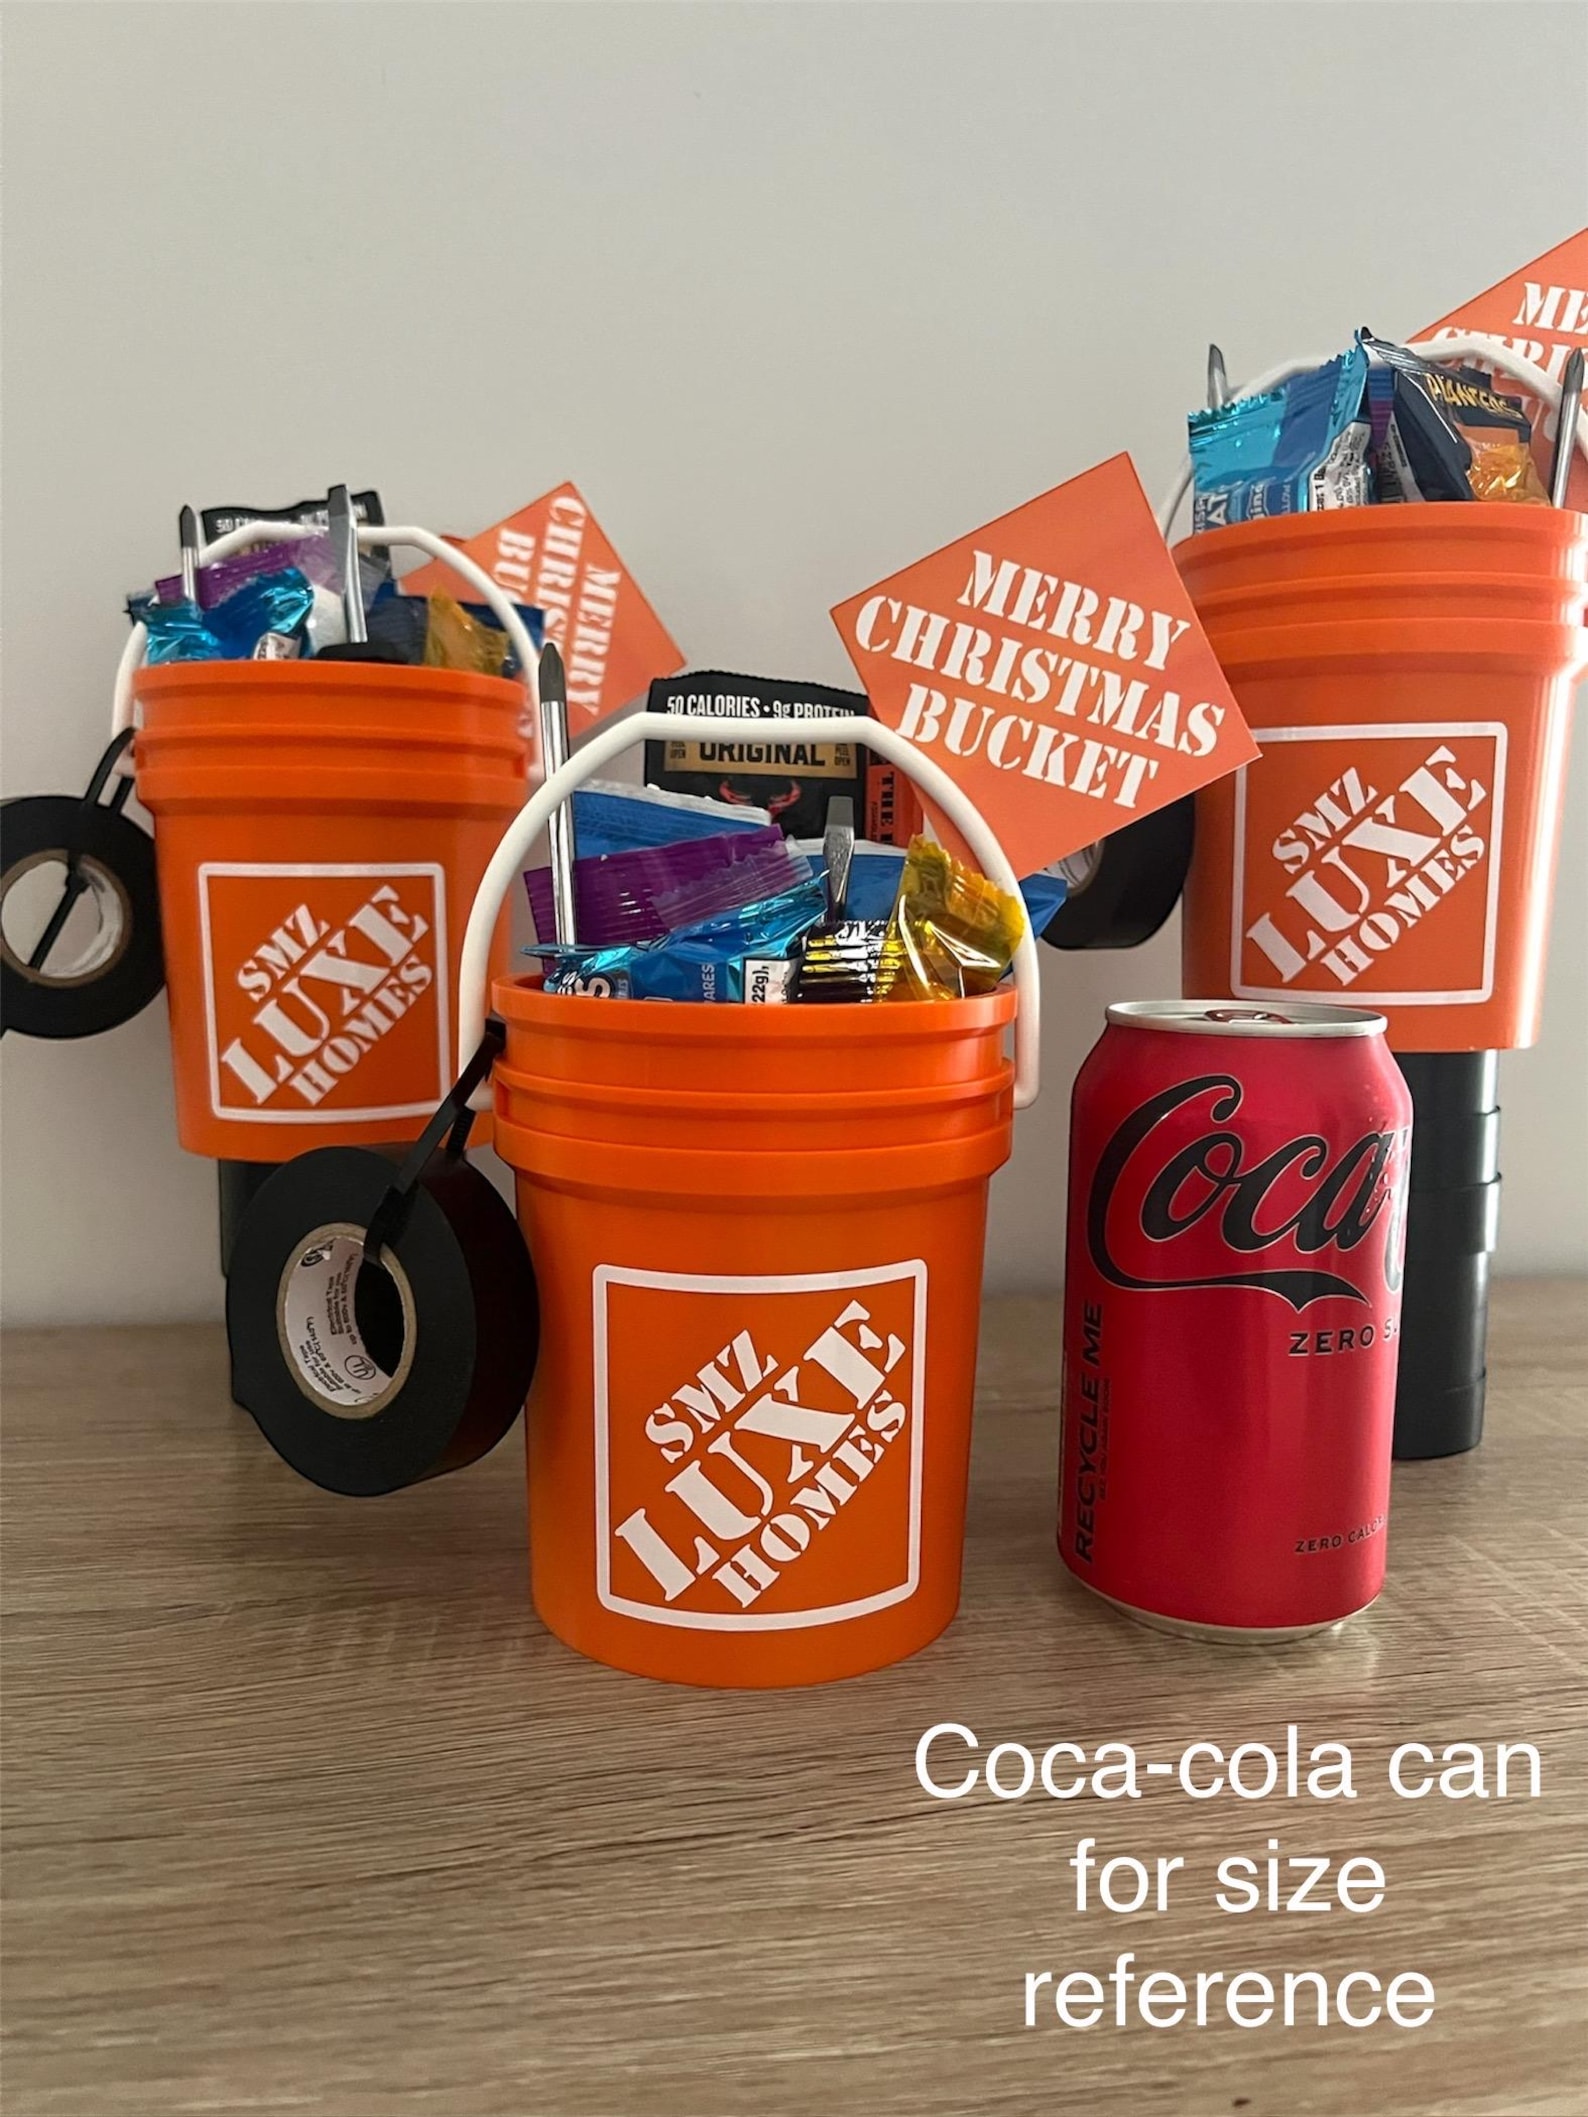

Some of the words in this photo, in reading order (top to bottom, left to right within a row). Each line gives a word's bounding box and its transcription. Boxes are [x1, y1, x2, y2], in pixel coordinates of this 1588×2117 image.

[1512, 281, 1588, 336] ME
[534, 496, 587, 652] CHRIS
[567, 562, 621, 716] MERRY
[957, 549, 1190, 671] MERRY
[667, 695, 685, 716] 50
[686, 694, 760, 718] CALORIES
[773, 699, 791, 718] 9g
[793, 702, 855, 718] PROTEIN
[855, 595, 1226, 757] CHRISTMAS
[699, 742, 826, 766] ORIGINAL
[895, 683, 1159, 809] BUCKET
[1246, 745, 1487, 983] LUXE
[1272, 767, 1378, 874] SMZ
[237, 903, 330, 1002] SMZ
[1320, 824, 1485, 986] HOMES
[221, 884, 429, 1105] LUXE
[289, 954, 432, 1106] HOMES
[701, 964, 717, 1003] ARES
[752, 966, 770, 1005] 22g),
[1087, 1074, 1393, 1313] Coca
[645, 1329, 779, 1463] SMZ
[1082, 1299, 1103, 1368] ME
[1288, 1324, 1375, 1357] ZERO
[615, 1299, 906, 1602] LUXE
[712, 1389, 906, 1608] HOMES
[1075, 1371, 1100, 1564] RECYCLE
[1294, 1535, 1342, 1555] ZERO
